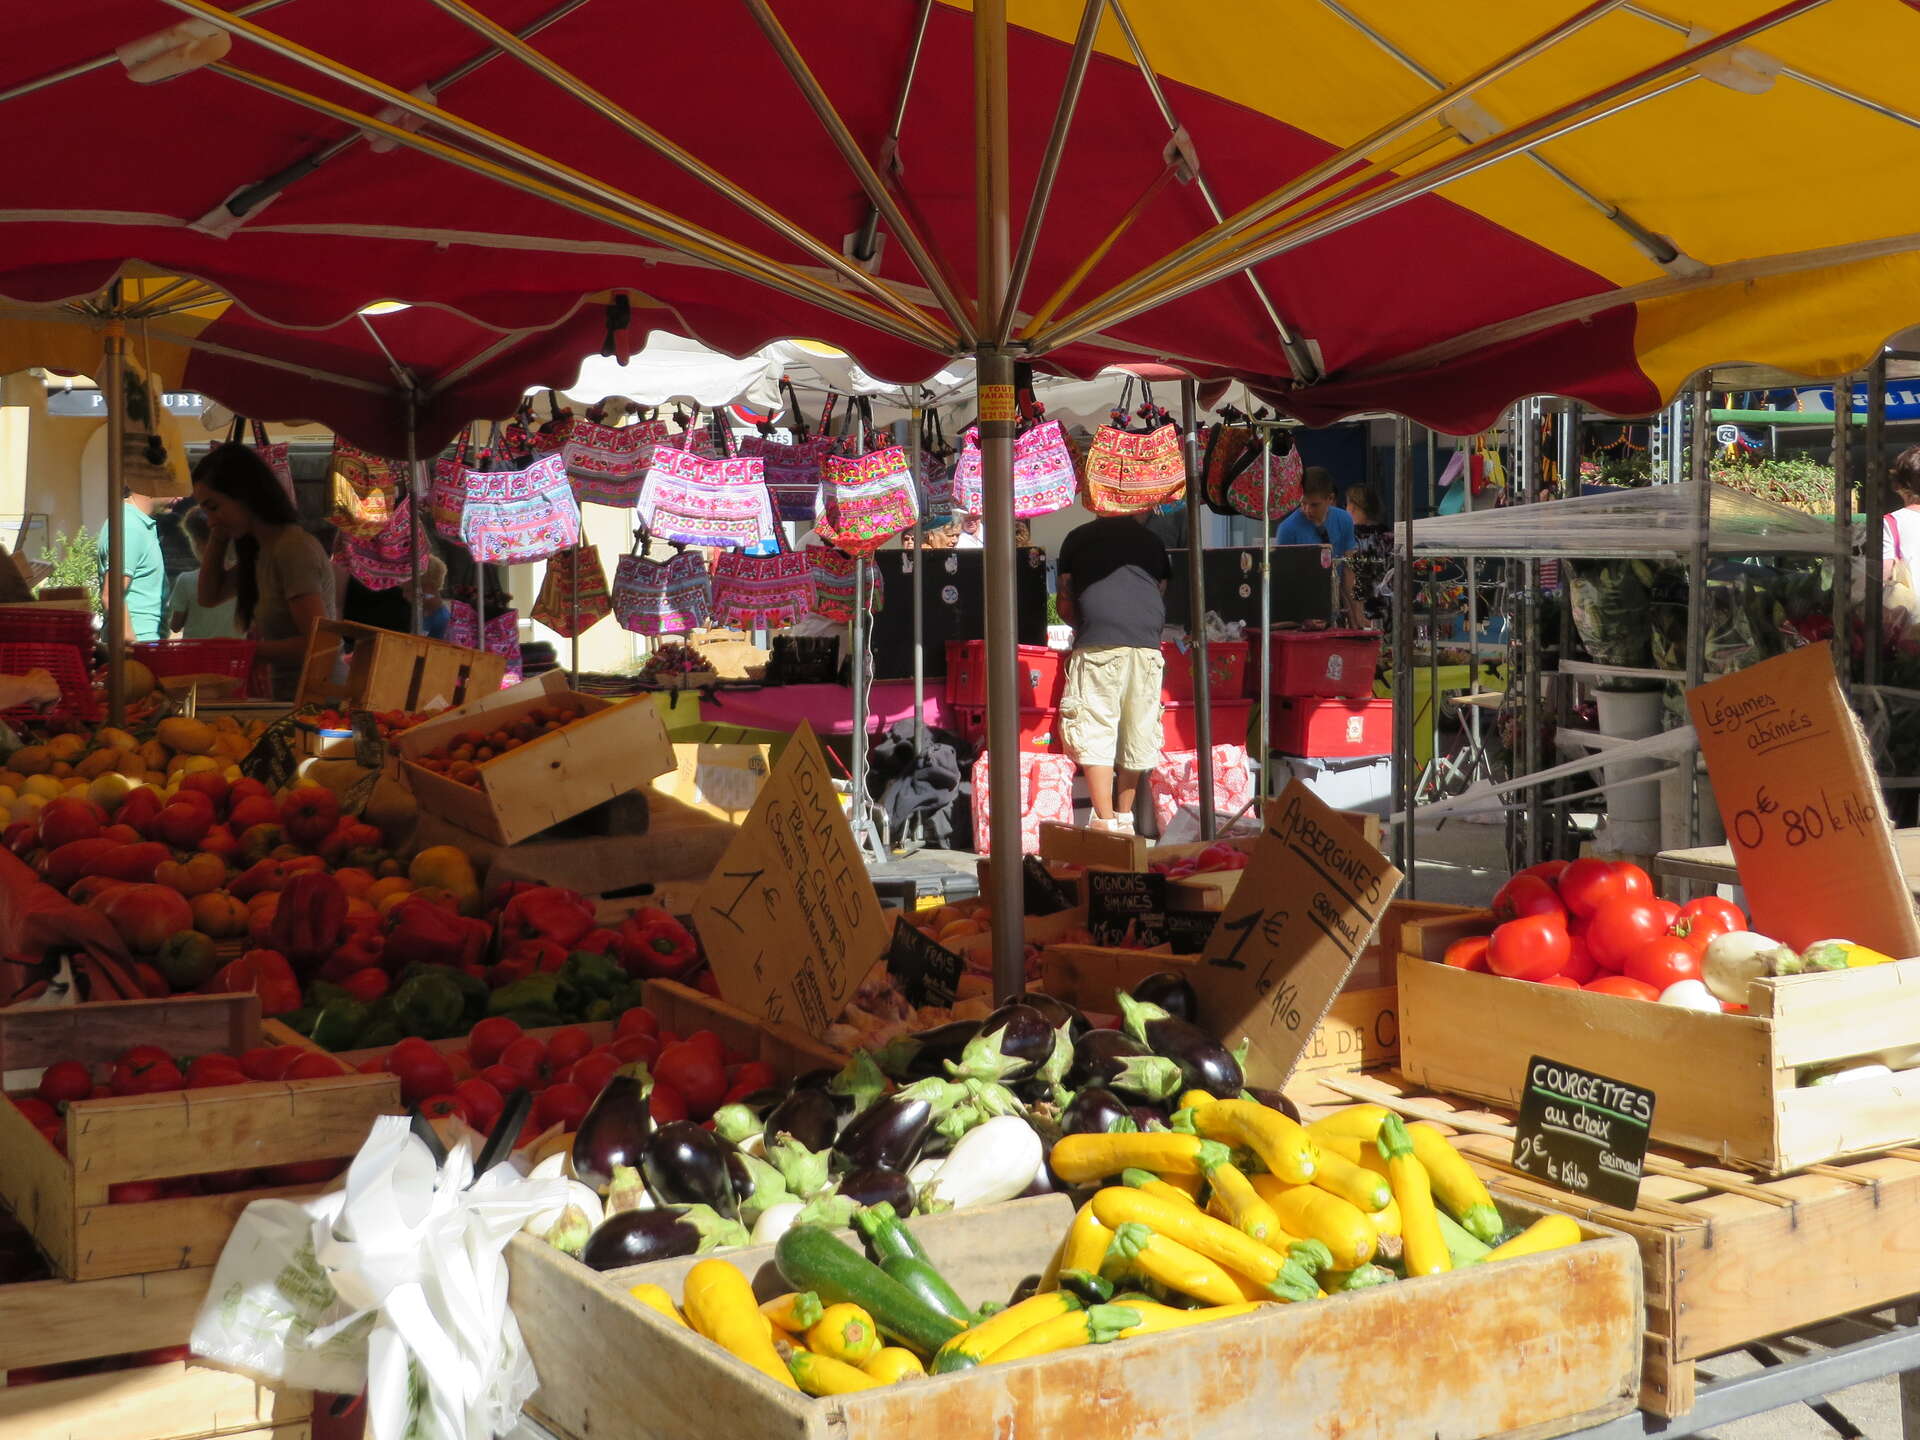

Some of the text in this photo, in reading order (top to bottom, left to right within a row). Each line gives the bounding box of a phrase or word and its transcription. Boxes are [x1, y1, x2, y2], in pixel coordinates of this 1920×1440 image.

[1702, 693, 1777, 732] Légumes
[794, 740, 862, 927] TOMATES
[1532, 1064, 1651, 1121] COURGETTES
[1544, 1105, 1611, 1139] au choix
